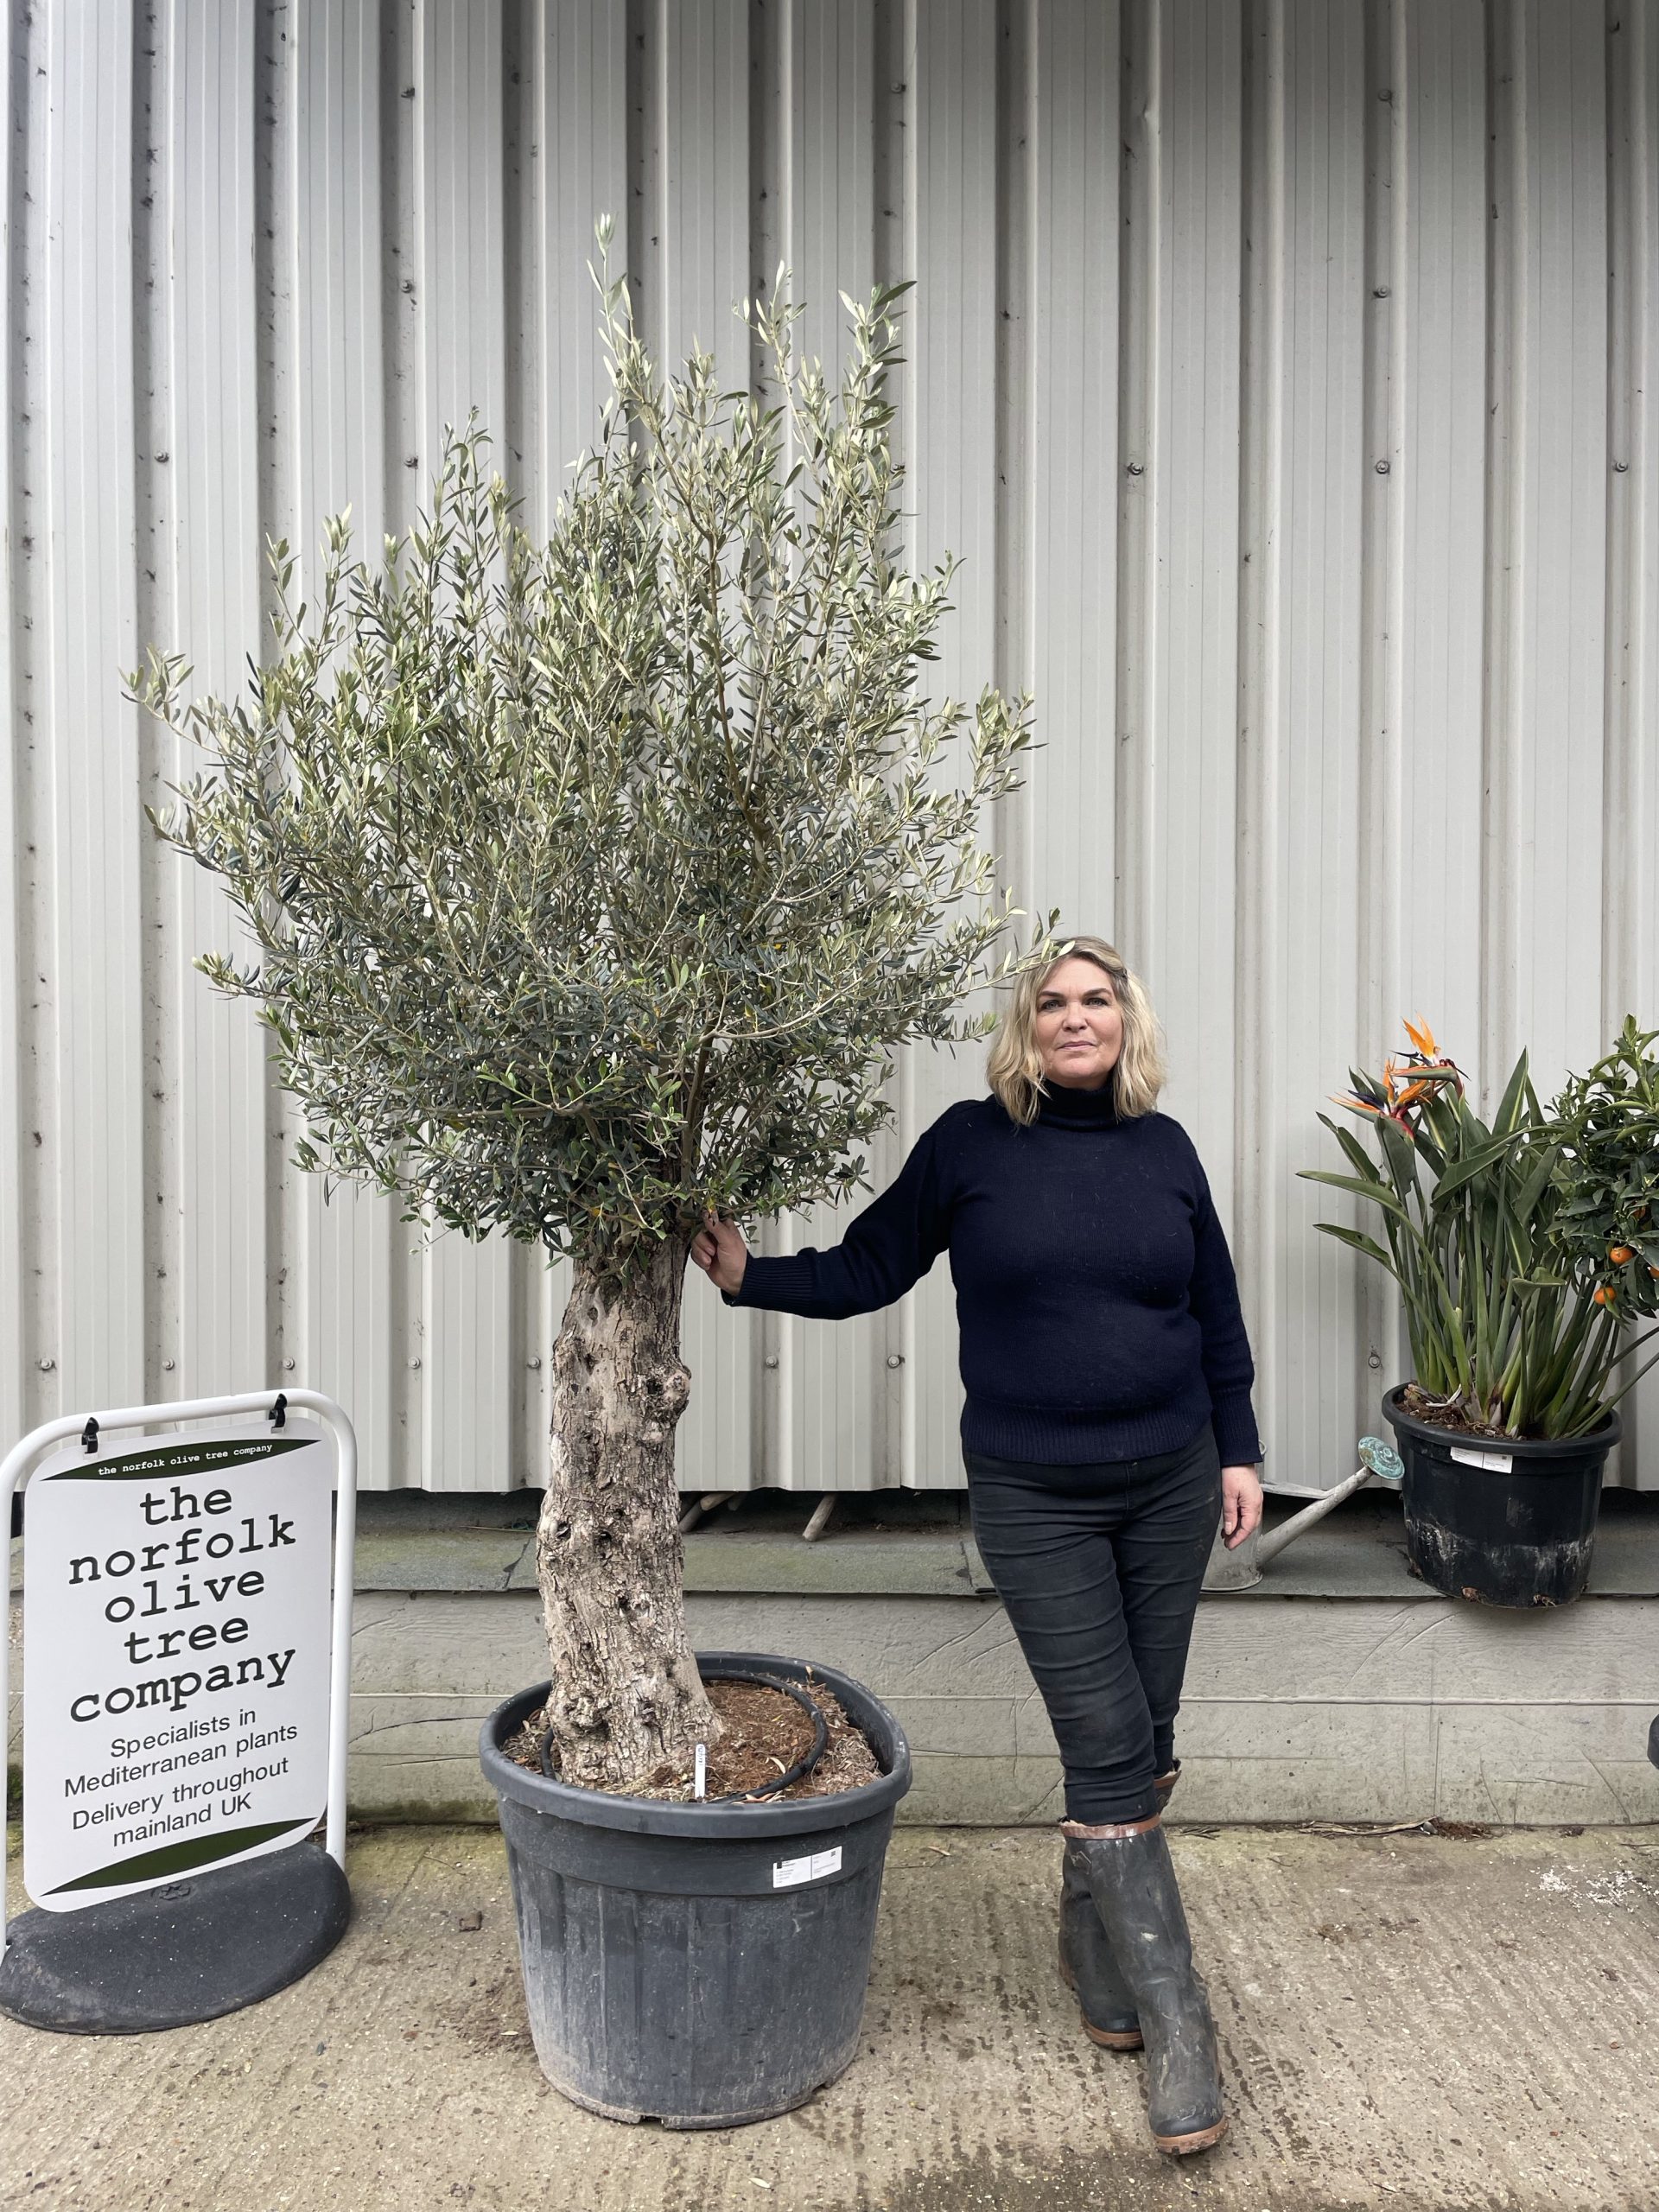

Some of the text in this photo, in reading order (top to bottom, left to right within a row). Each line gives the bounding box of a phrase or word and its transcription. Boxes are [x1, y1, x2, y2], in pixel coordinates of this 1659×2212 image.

[99, 1444, 273, 1476] the norfolk olive tree company
[139, 1485, 232, 1525] the
[68, 1513, 296, 1585] norfolk
[105, 1570, 264, 1624] olive
[124, 1618, 249, 1664] tree
[70, 1649, 296, 1723] company
[111, 1708, 256, 1759] Specialists in
[65, 1726, 298, 1797] Mediterranean plants
[73, 1757, 289, 1830] Delivery throughout
[113, 1791, 252, 1847] mainland UK
